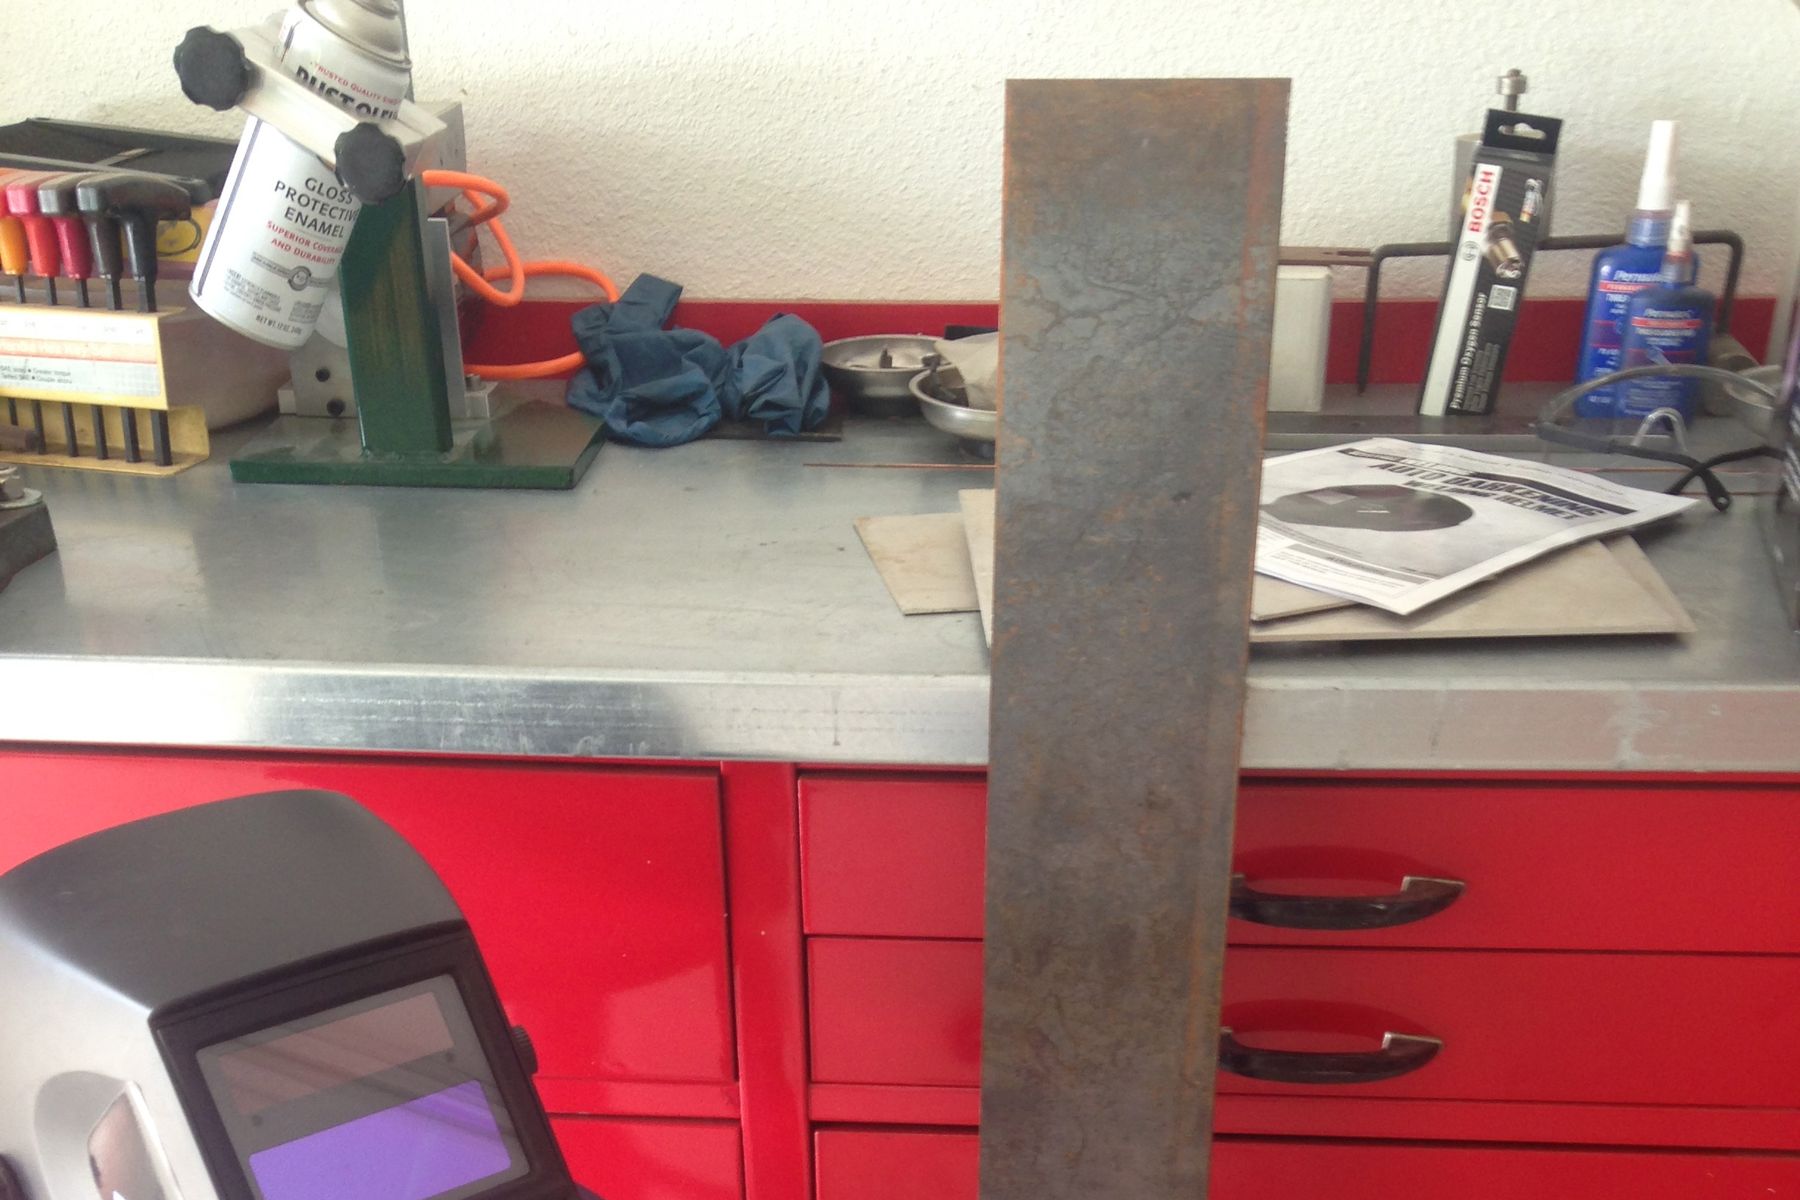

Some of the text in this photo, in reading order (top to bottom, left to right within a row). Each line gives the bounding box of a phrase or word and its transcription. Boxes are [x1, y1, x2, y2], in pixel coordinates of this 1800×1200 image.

[274, 180, 361, 222] PROTECTIV
[304, 177, 353, 205] GLOSS
[1468, 170, 1494, 233] BOSCH
[267, 220, 311, 247] SUPERIOR
[284, 207, 345, 239] ENAMEL
[271, 238, 292, 252] AND
[1449, 366, 1469, 409] Premium
[1460, 328, 1478, 366] Oxygen
[1469, 292, 1487, 328] Sensor
[1369, 461, 1445, 484] AUTO
[1444, 474, 1606, 518] DARKENING
[1402, 479, 1581, 520] WELDING HELMET
